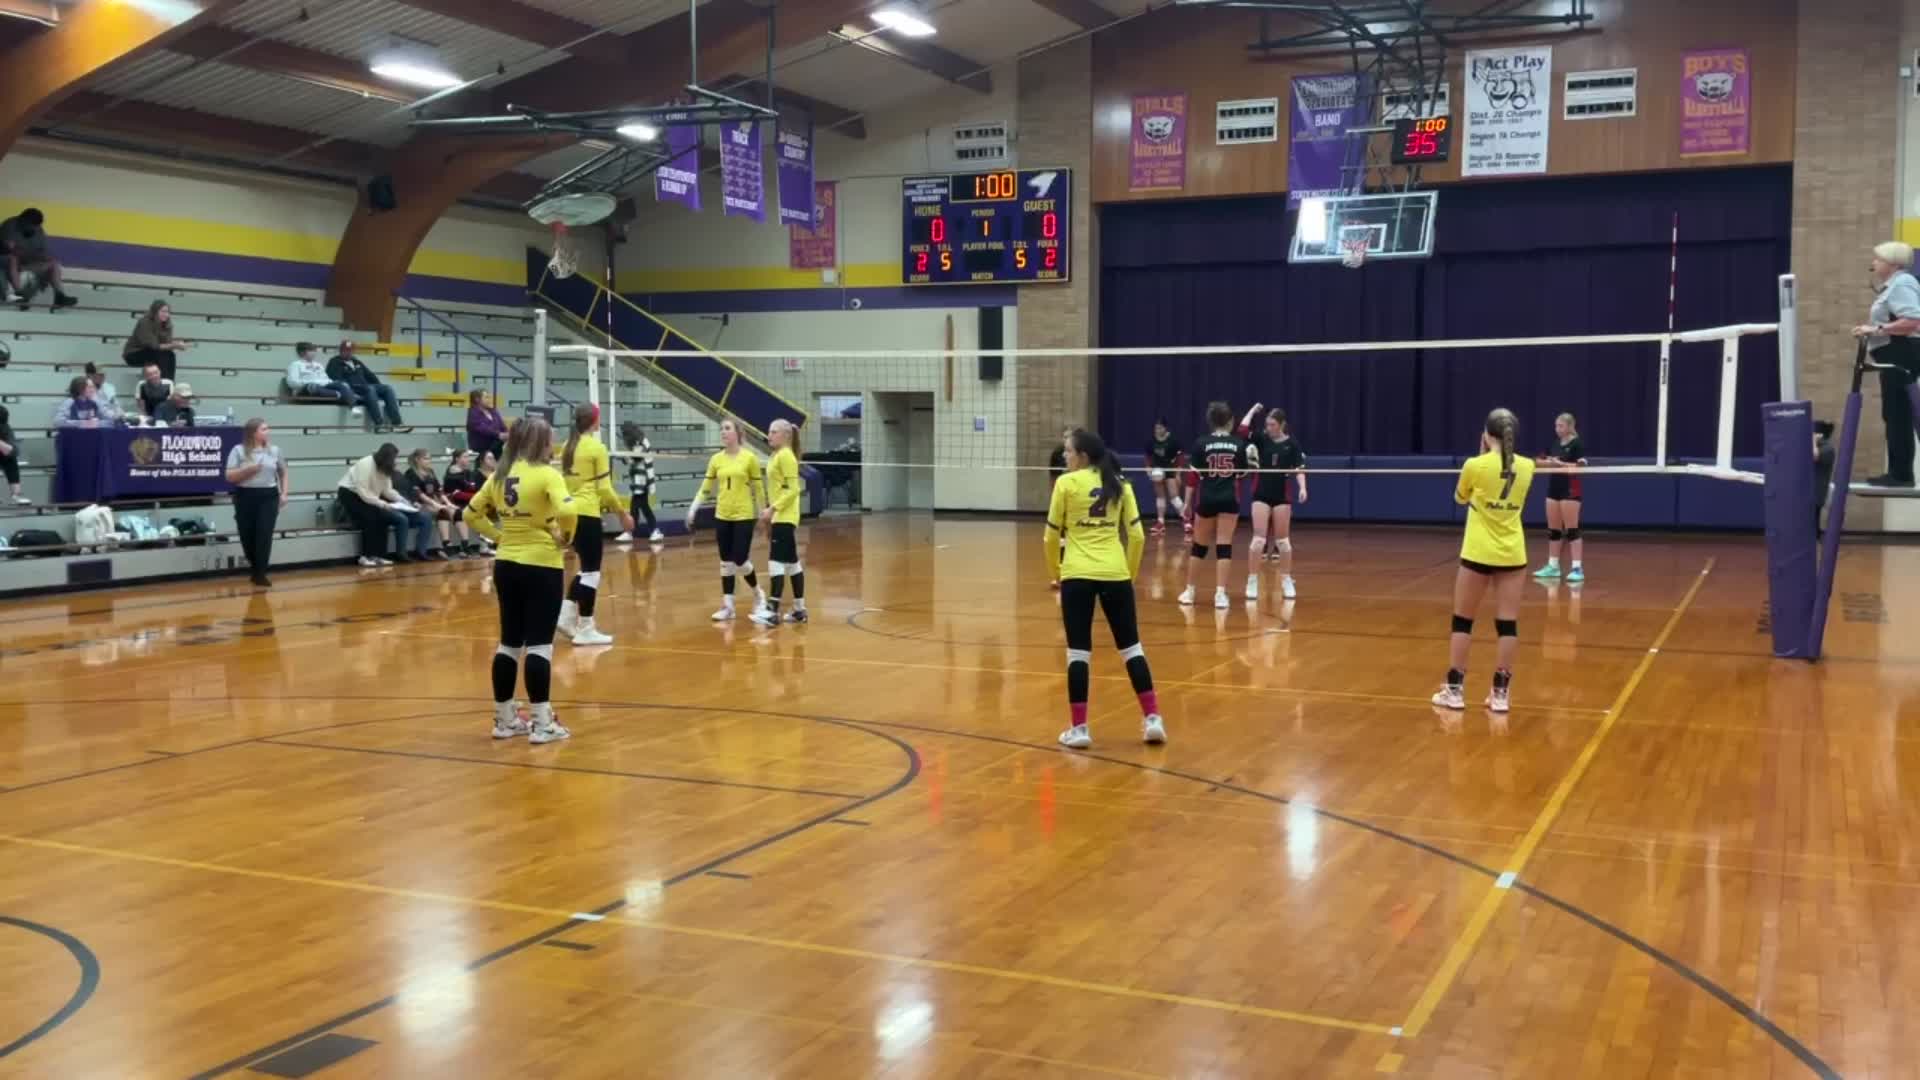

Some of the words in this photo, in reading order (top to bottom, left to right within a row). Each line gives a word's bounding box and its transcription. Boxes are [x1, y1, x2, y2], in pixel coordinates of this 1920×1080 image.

[1485, 58, 1509, 71] Act
[1514, 55, 1546, 71] Play
[1314, 113, 1341, 127] BAND
[1403, 133, 1438, 156] 35
[975, 173, 1014, 198] 1:00
[914, 205, 942, 216] HOME
[1023, 199, 1056, 212] GUEST
[931, 217, 944, 241] 0
[983, 219, 989, 237] 1
[1043, 213, 1057, 238] 0
[917, 253, 929, 273] 2
[941, 252, 952, 271] 5
[1015, 249, 1027, 268] 5
[1045, 249, 1057, 268] 2
[162, 435, 222, 450] FLOODWOOD
[162, 451, 187, 465] High
[188, 451, 221, 462] School
[1206, 453, 1236, 478] 15
[504, 477, 520, 507] 5
[1499, 471, 1517, 500] 7
[1088, 487, 1107, 518] 2
